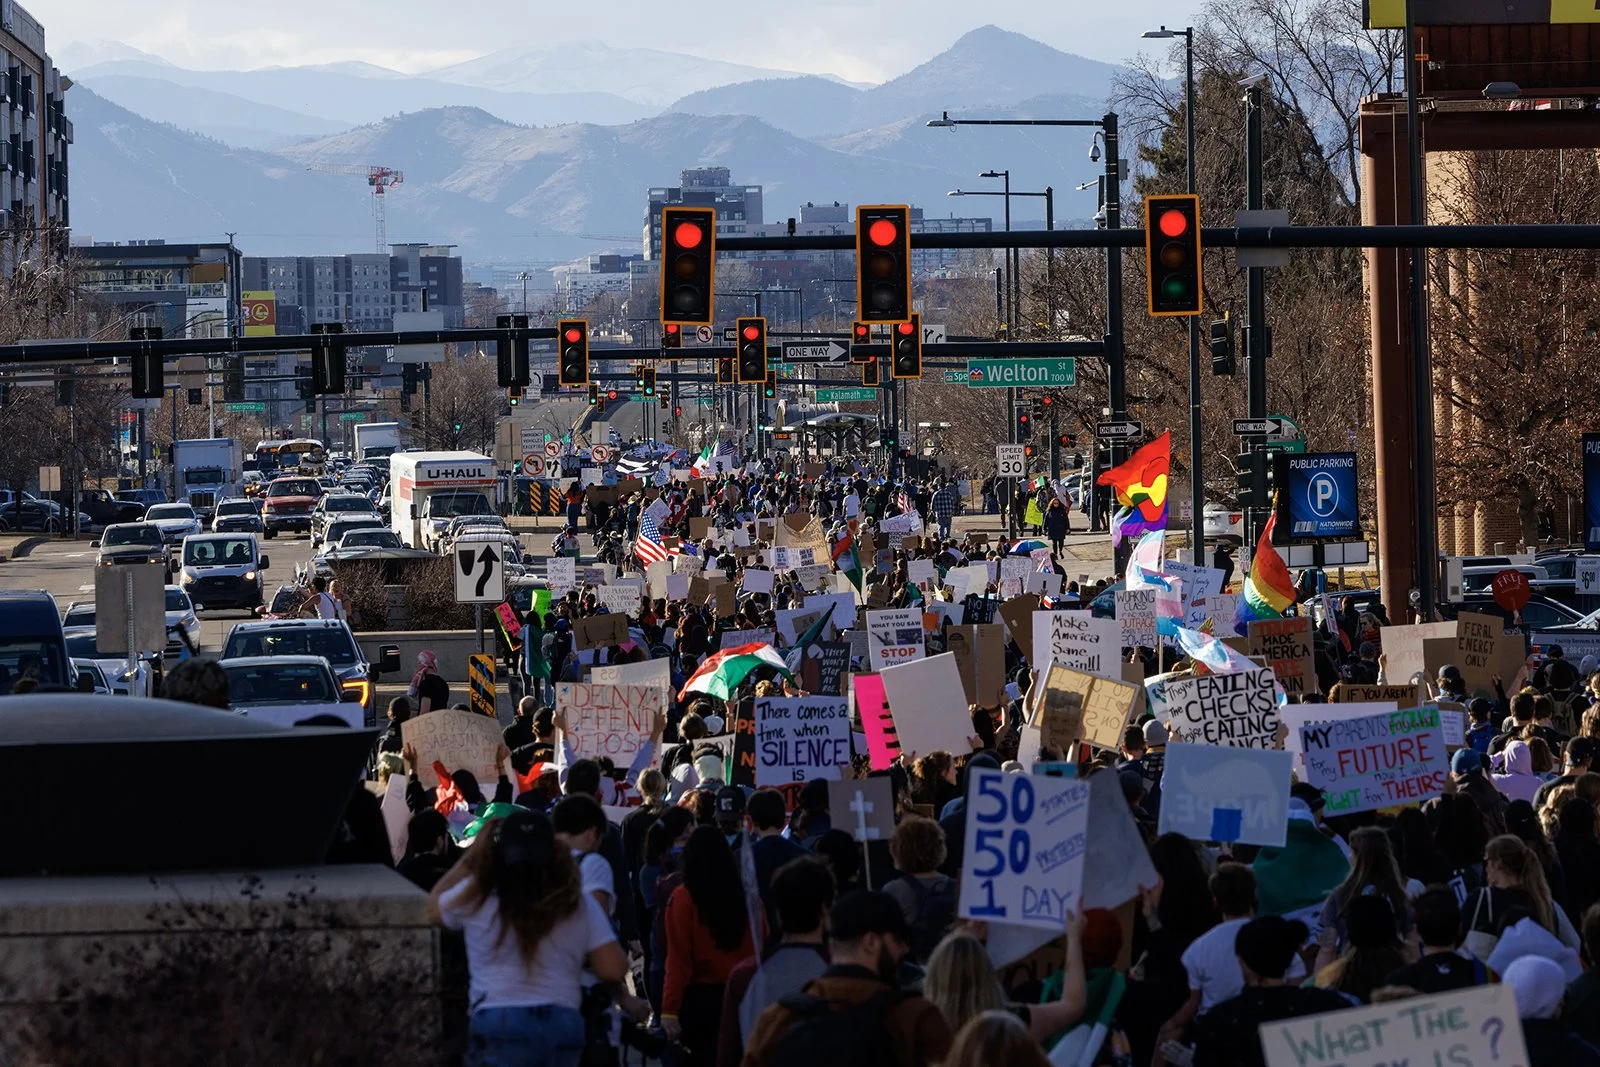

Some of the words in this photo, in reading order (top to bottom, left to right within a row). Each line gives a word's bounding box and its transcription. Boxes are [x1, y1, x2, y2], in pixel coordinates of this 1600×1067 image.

[788, 347, 808, 357] ONE
[810, 346, 830, 356] WAY
[954, 372, 968, 380] Spe
[986, 364, 1048, 382] Welton
[1058, 362, 1066, 370] St
[1051, 374, 1064, 382] 700
[830, 391, 861, 400] Kalamath
[1001, 462, 1022, 474] 30
[1290, 459, 1318, 469] PUBLIC
[1320, 458, 1354, 468] PARKING
[1316, 480, 1333, 510] P
[1496, 572, 1524, 588] FREE
[1116, 590, 1156, 602] WORKING
[968, 600, 982, 610] NO
[1124, 601, 1148, 612] CLASS
[1052, 614, 1088, 632] Make
[1121, 618, 1156, 628] OUTRAGE
[1464, 620, 1494, 639] FERAL
[1051, 628, 1100, 644] America
[1122, 634, 1154, 646] POWER
[1262, 633, 1296, 646] MADE
[824, 648, 845, 657] THEY
[881, 647, 916, 658] STOP
[1052, 642, 1088, 657] Sane
[1252, 644, 1310, 660] AMERICA
[1458, 637, 1496, 654] ENERGY
[822, 658, 845, 667] WON'T
[1268, 658, 1304, 678] ATE
[1464, 654, 1488, 668] ONLY
[821, 668, 840, 676] STOP
[1196, 668, 1274, 700] EATING
[572, 684, 650, 708] DENY
[1347, 688, 1357, 698] IF
[1362, 688, 1380, 700] YOU
[1382, 686, 1416, 698] AREN'T
[756, 702, 791, 720] There
[798, 704, 840, 719] comes
[839, 704, 848, 718] a
[1185, 689, 1278, 722] CHECKS!
[758, 723, 786, 742] time
[793, 723, 830, 737] when
[1204, 712, 1278, 743] EATING
[1303, 726, 1332, 752] MY
[1335, 715, 1388, 745] PARENTS
[568, 732, 650, 752] DEPOSE
[760, 738, 849, 767] SILENCE
[1310, 757, 1326, 771] for
[1321, 767, 1337, 782] my
[1338, 733, 1434, 778] FUTURE
[792, 768, 805, 782] is
[1374, 772, 1396, 782] now
[1400, 766, 1408, 778] I
[1410, 764, 1428, 775] will
[976, 774, 1036, 824] 50
[1040, 784, 1089, 814] STATES
[1324, 788, 1361, 812] IGHT
[1364, 788, 1385, 804] for
[1382, 770, 1447, 800] THEIRS
[973, 828, 1031, 877] 50
[1034, 832, 1087, 869] PROTESTS
[969, 879, 1007, 917] 1
[1022, 885, 1073, 915] DAY
[1396, 1002, 1470, 1040] THE
